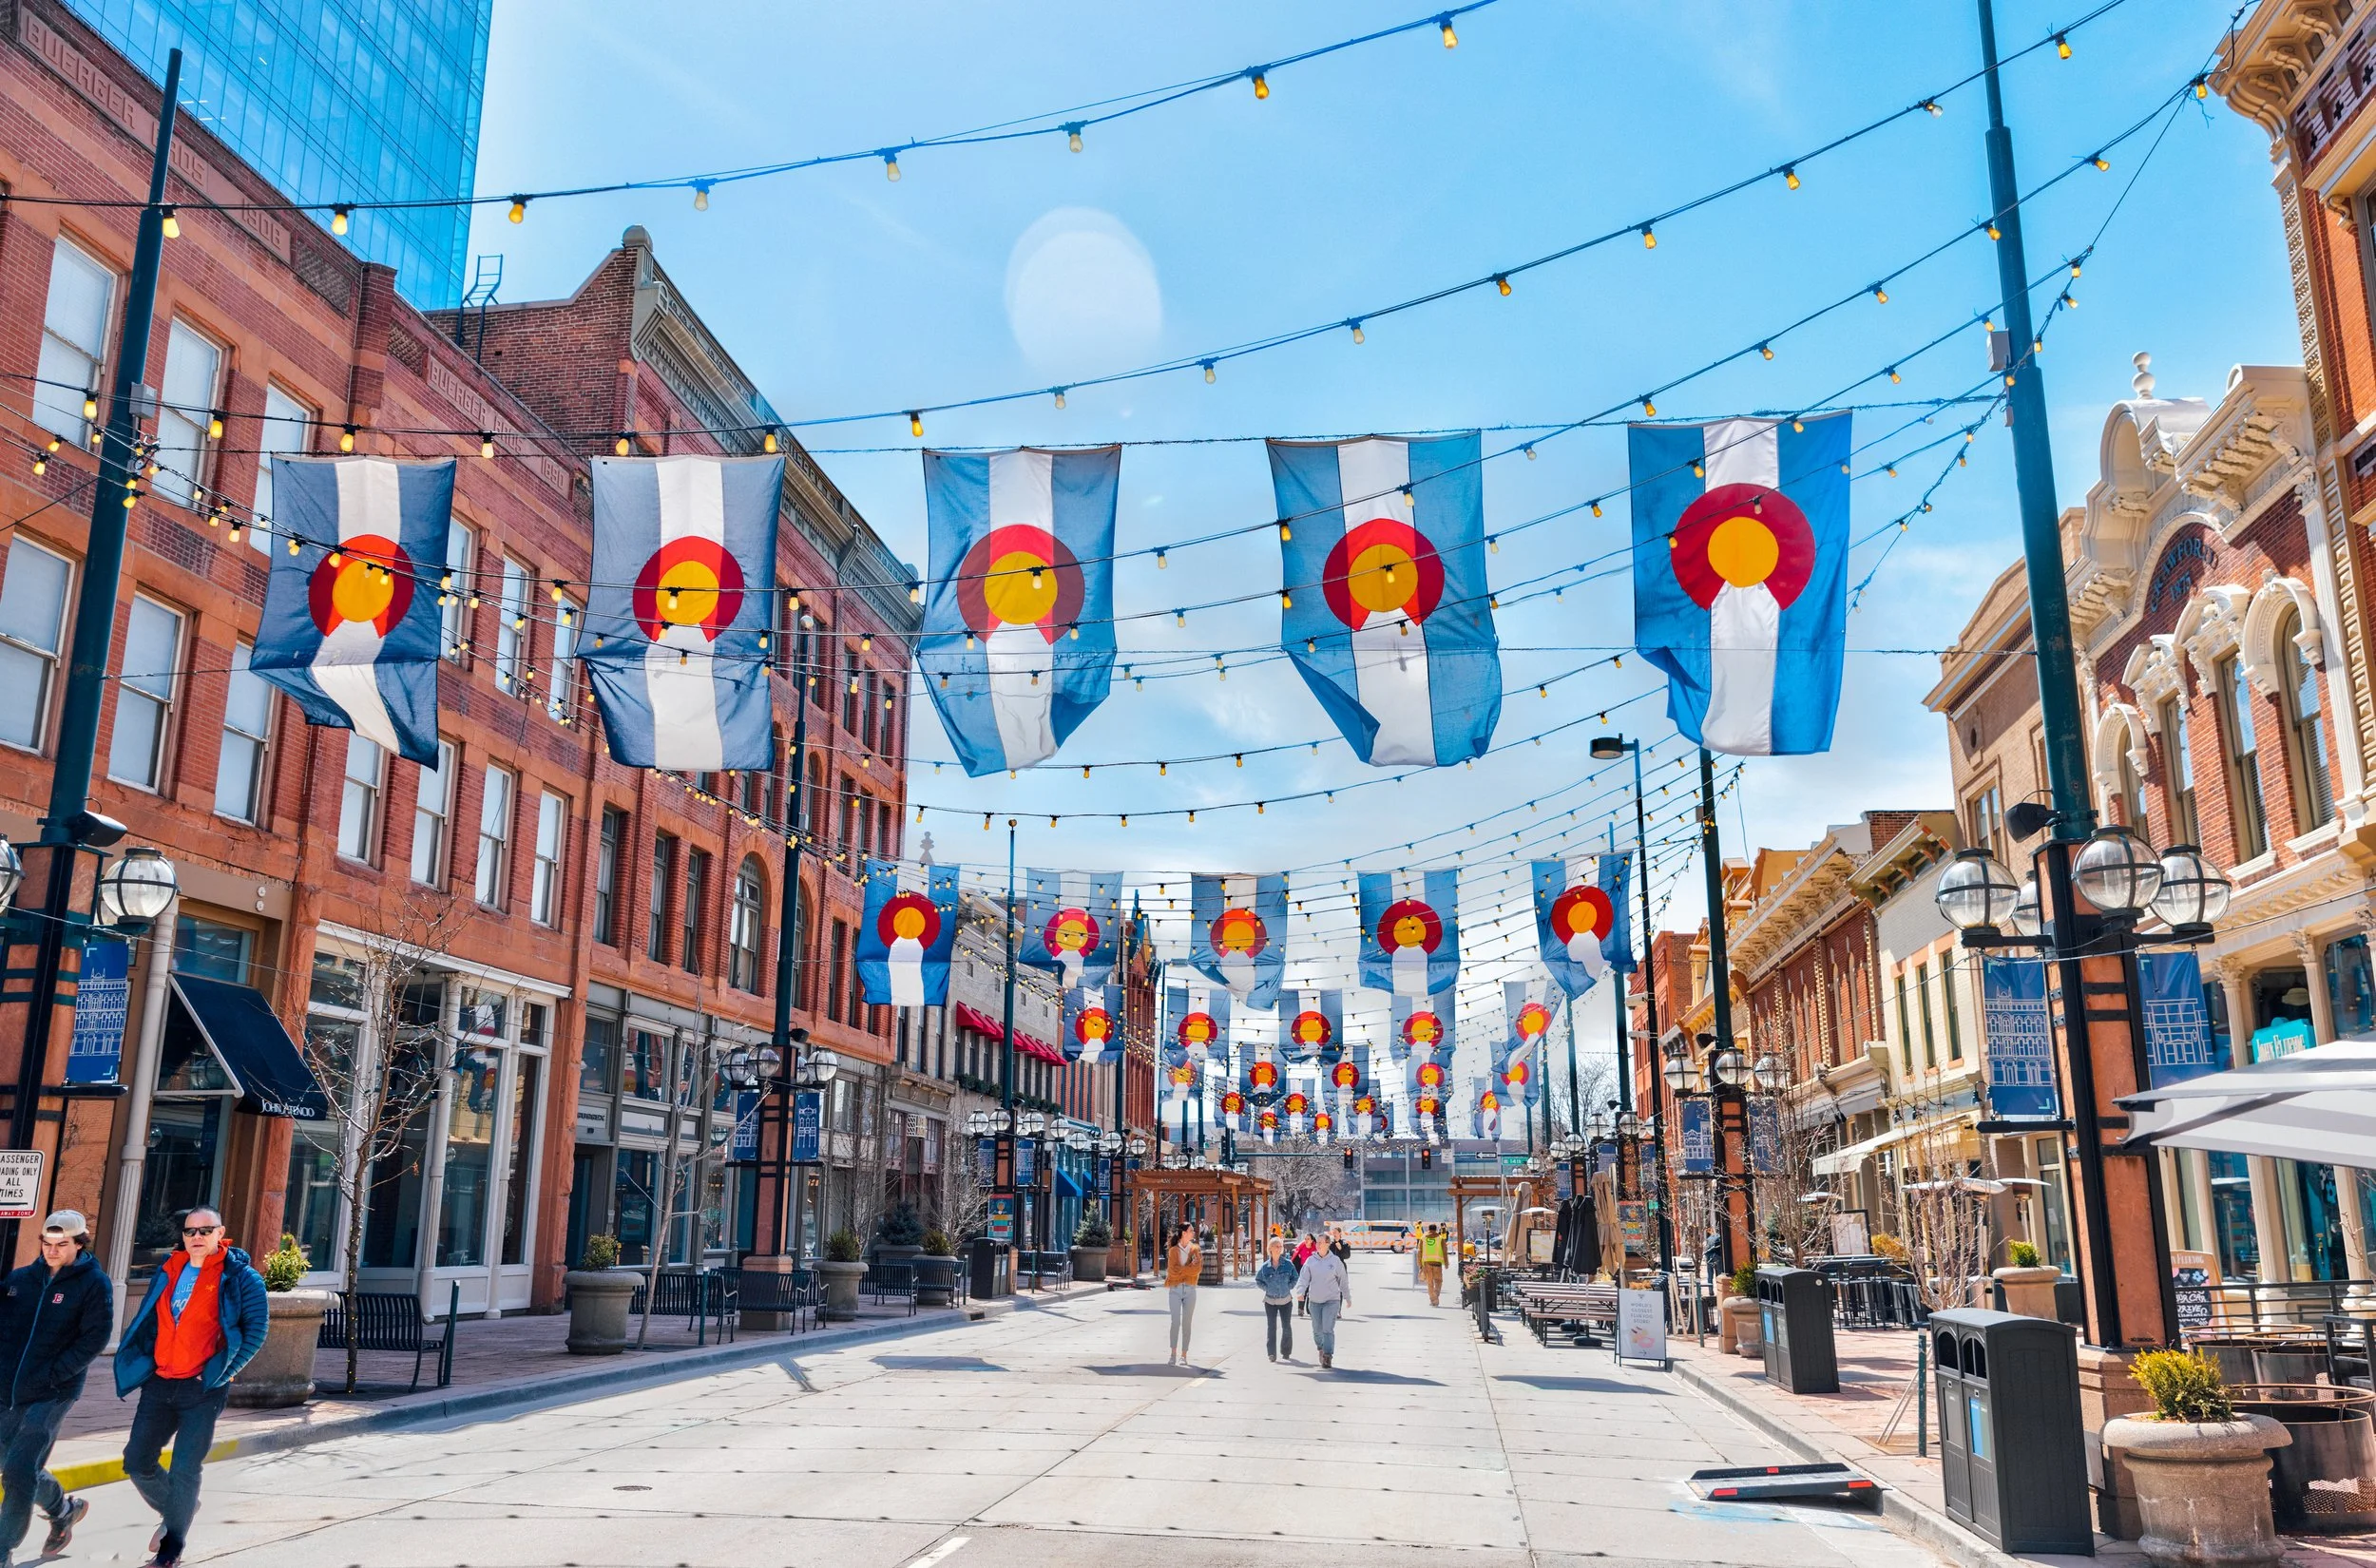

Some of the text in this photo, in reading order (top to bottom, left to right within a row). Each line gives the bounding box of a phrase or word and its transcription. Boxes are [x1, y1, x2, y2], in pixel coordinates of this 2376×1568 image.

[26, 15, 136, 130] BUERGER
[241, 198, 283, 251] 1908
[431, 361, 488, 427] BUERGER
[494, 415, 524, 455] BROS
[2151, 538, 2215, 613] CRAWFORD
[260, 1100, 282, 1114] JOHN
[0, 1155, 39, 1164] ASSENGER
[0, 1167, 38, 1176] ADING ONLY
[6, 1177, 21, 1186] ALL
[0, 1188, 24, 1197] TIMES
[52, 1293, 64, 1304] E
